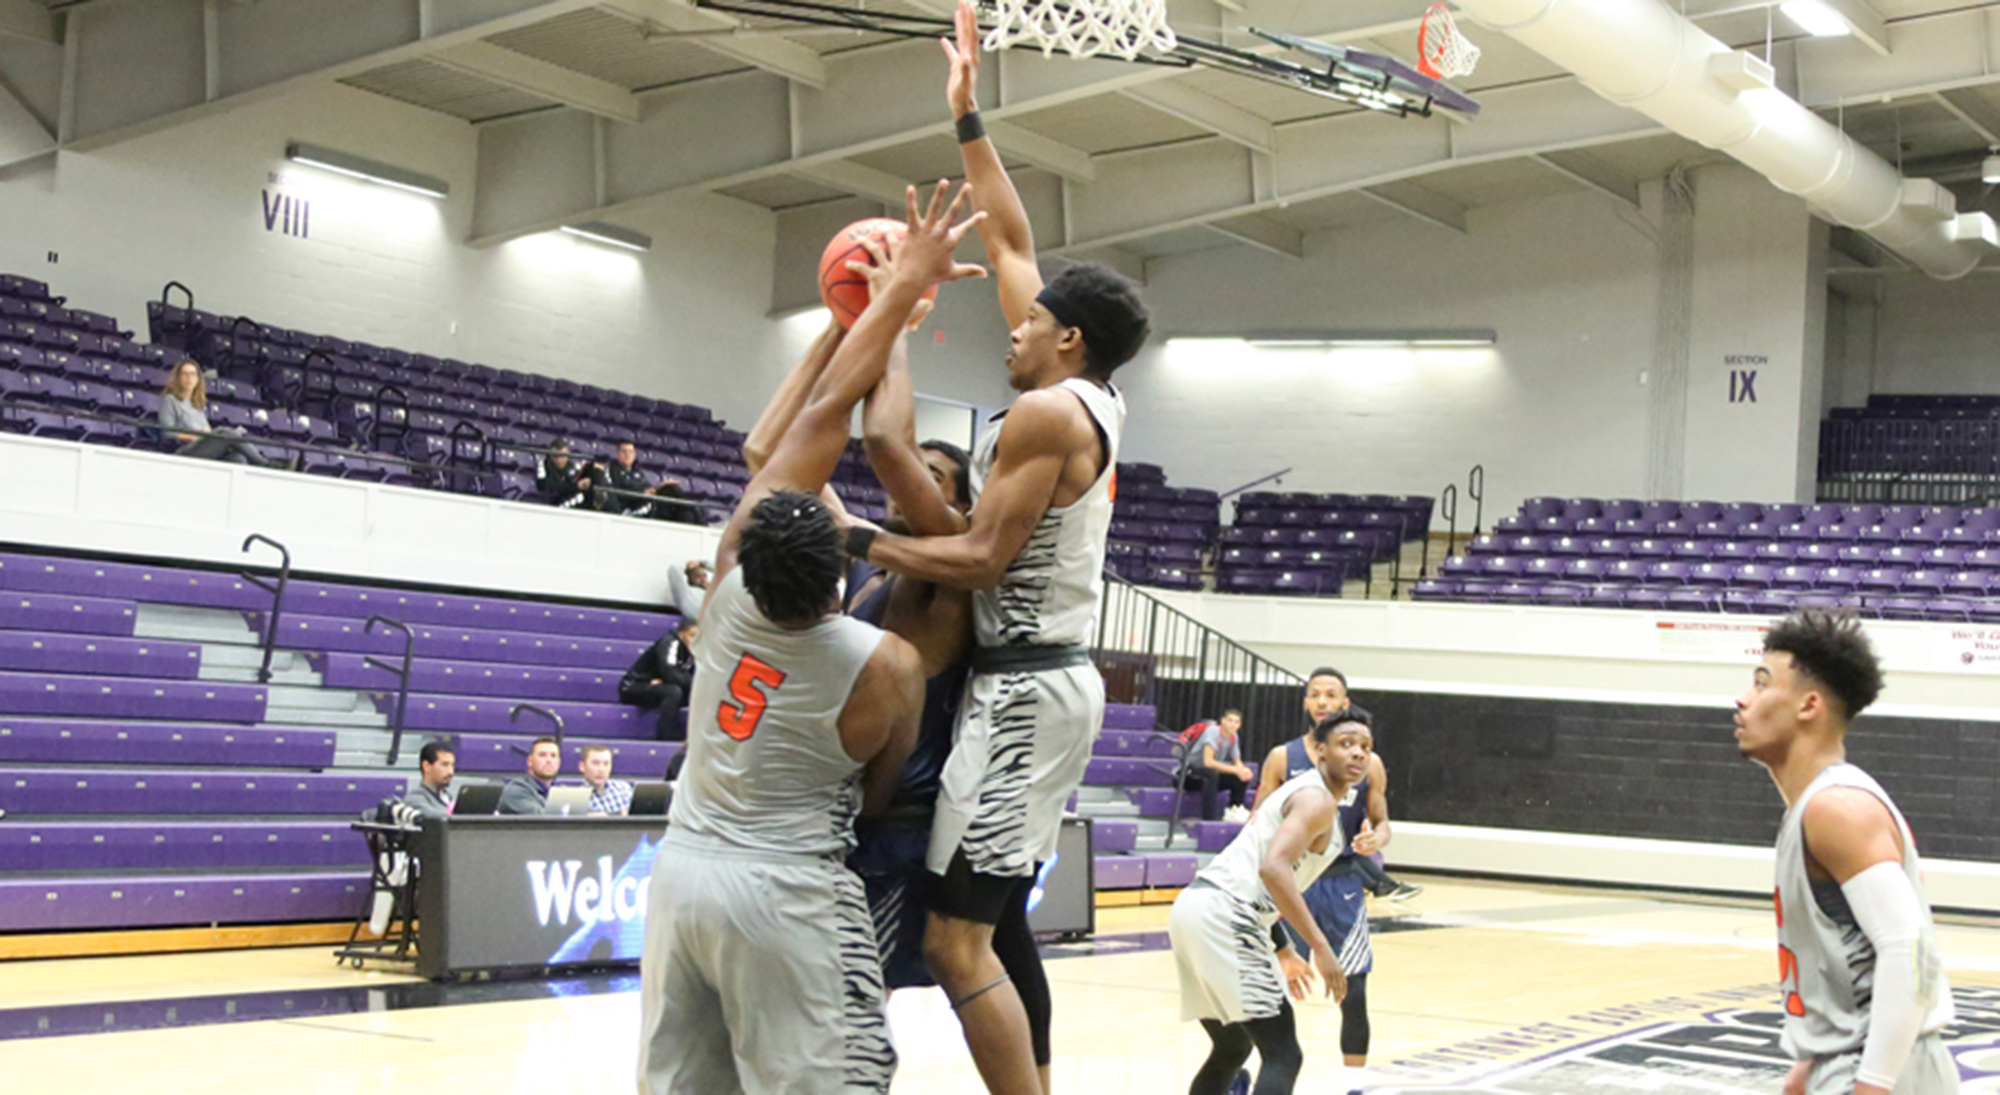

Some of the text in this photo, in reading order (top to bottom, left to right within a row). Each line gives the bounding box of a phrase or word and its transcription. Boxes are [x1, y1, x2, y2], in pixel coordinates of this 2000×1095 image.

[262, 188, 309, 238] VIII
[1724, 355, 1768, 365] SECTION
[1729, 370, 1757, 403] IX
[716, 650, 787, 742] 5
